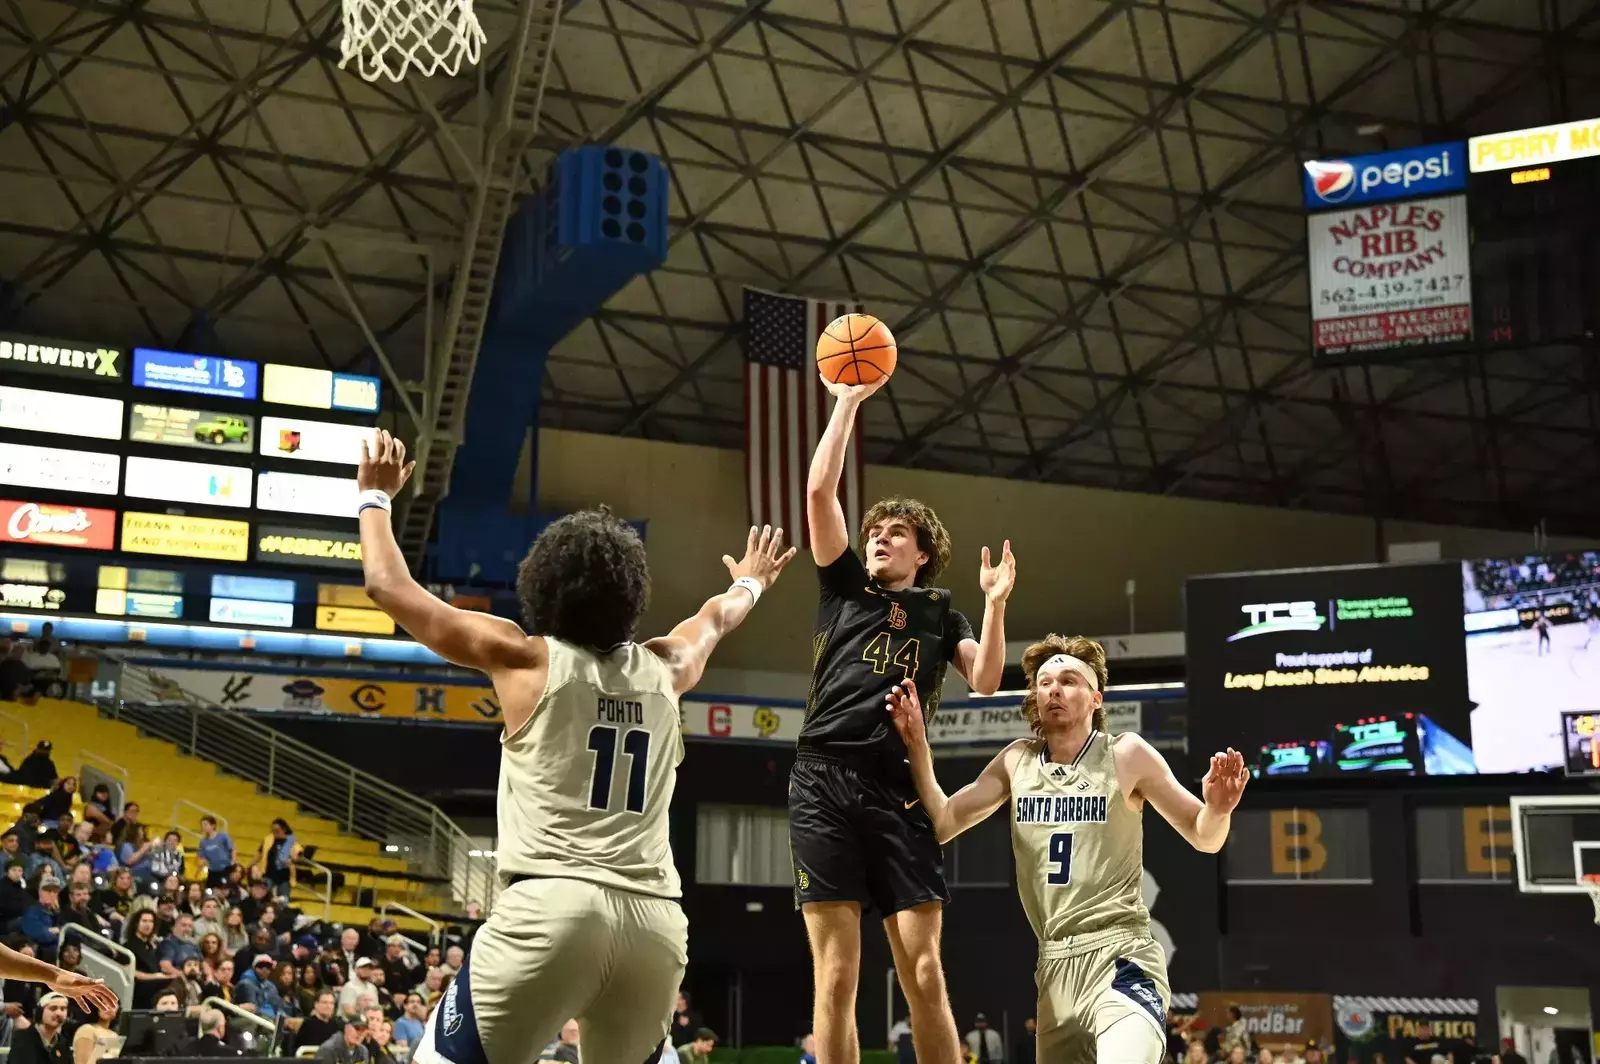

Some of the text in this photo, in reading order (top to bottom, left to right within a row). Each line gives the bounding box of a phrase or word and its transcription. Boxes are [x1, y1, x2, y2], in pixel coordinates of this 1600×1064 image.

[1477, 131, 1559, 165] PERRY
[1361, 151, 1450, 193] pepsi
[1329, 204, 1445, 246] NAPLES
[1360, 229, 1418, 258] RIB
[1333, 241, 1446, 280] COMPANY
[1320, 274, 1465, 306] 562-439-7427
[1241, 601, 1317, 626] TCS
[862, 632, 920, 681] 44
[1223, 664, 1430, 690] Long Beach State Athletics
[597, 698, 644, 724] POHTO
[586, 724, 652, 815] 11
[1016, 796, 1107, 823] SANTA BARBARA
[1270, 807, 1512, 874] B E
[1047, 831, 1075, 886] 9
[1246, 1012, 1305, 1034] ndBar
[1387, 1014, 1476, 1039] PAFICO
